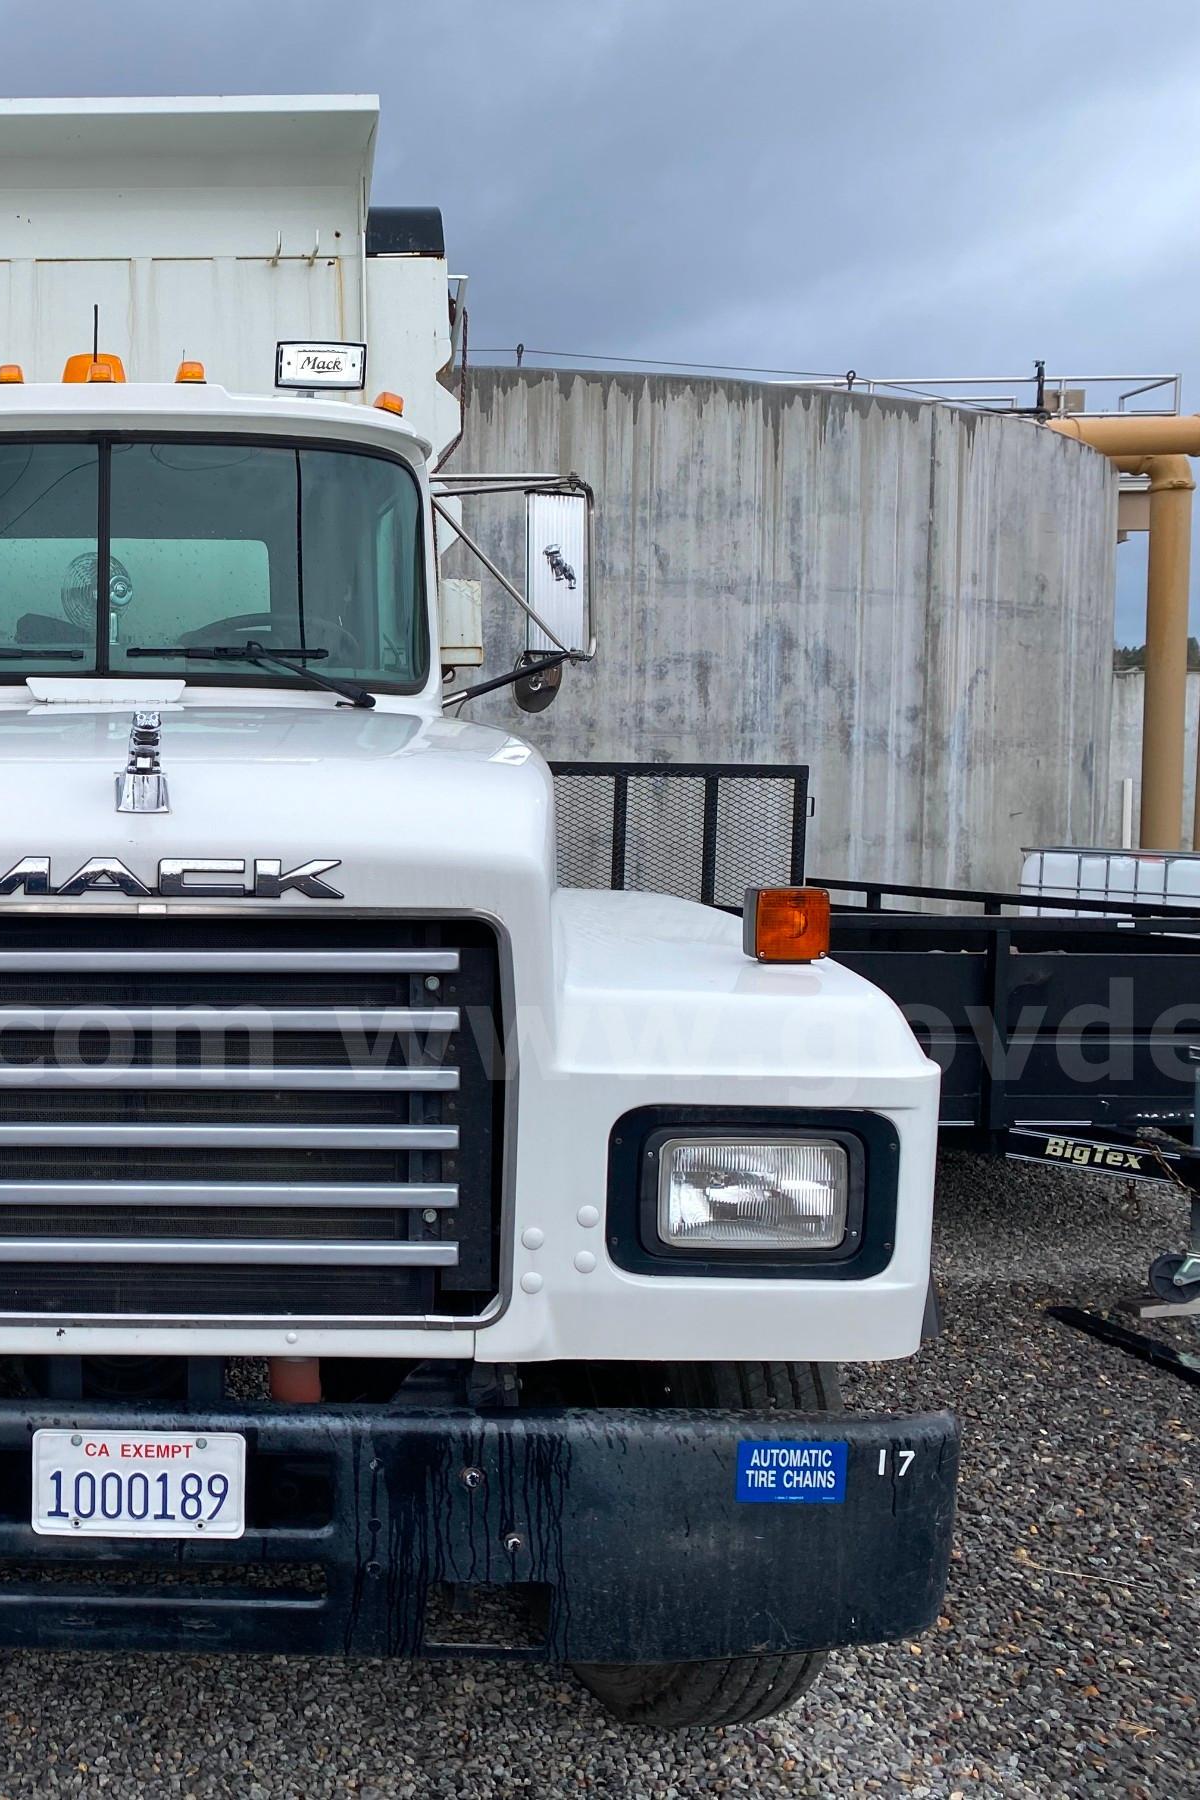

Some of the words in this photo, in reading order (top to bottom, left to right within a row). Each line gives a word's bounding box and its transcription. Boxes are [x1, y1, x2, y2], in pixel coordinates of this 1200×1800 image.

[299, 356, 343, 373] Mack
[84, 1443, 110, 1457] CA
[120, 1443, 193, 1459] EXEMPT
[750, 1449, 833, 1468] AUTOMATIC
[746, 1470, 776, 1488] TIRE
[783, 1470, 836, 1489] CHAINS
[47, 1470, 229, 1520] 1000189
